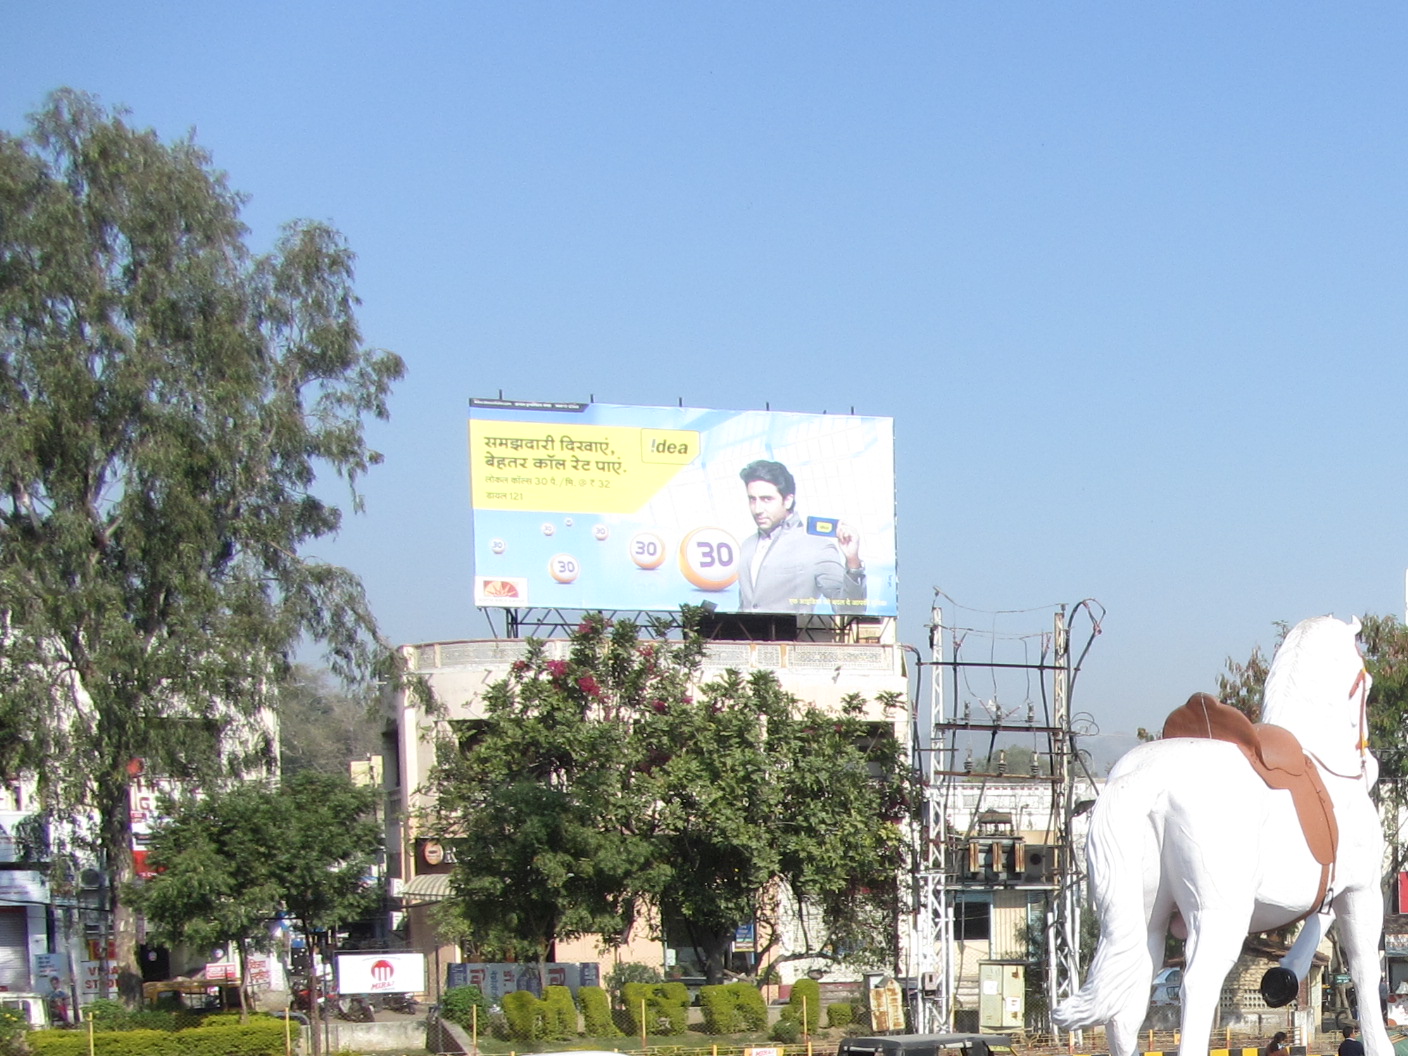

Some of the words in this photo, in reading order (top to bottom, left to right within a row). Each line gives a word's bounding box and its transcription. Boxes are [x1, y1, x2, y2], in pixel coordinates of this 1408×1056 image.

[484, 435, 555, 452] समझदारी
[485, 451, 528, 470] बेहतर
[533, 454, 566, 471] कॉल
[570, 455, 591, 472] रेट
[535, 477, 548, 486] 30
[598, 480, 611, 489] 32
[595, 527, 606, 536] 30
[492, 541, 503, 550] 30
[635, 541, 657, 556] 30
[696, 541, 734, 568] 30
[557, 560, 576, 573] 30
